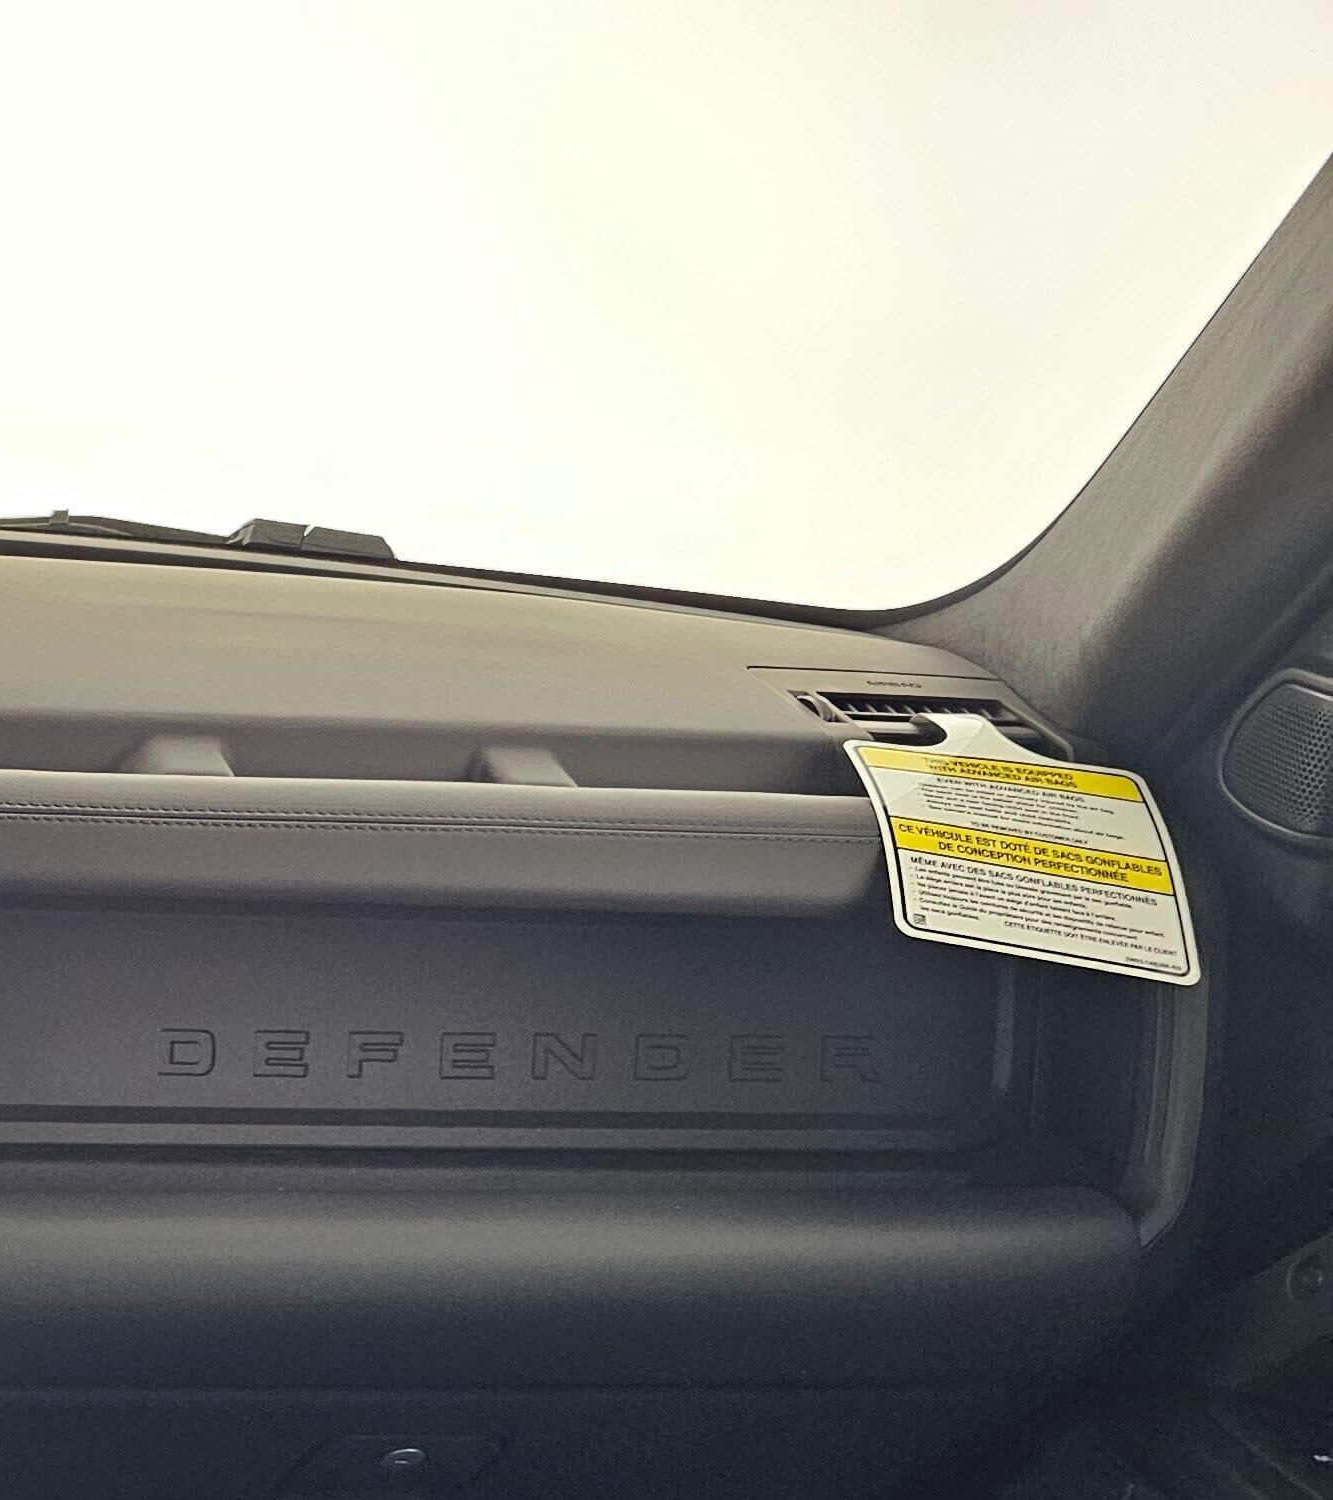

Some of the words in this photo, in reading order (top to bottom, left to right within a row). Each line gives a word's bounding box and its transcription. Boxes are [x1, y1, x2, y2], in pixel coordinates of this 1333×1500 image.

[899, 824, 914, 833] CE
[916, 826, 973, 844] VÉHICULE
[976, 836, 996, 848] EST
[1000, 840, 1031, 854] DOTÉ
[1034, 847, 1049, 857] DE
[1052, 849, 1082, 862] SACS
[1086, 855, 1162, 876] GONFLABLES
[938, 841, 954, 852] DE
[957, 845, 1031, 865] CONCEPTION
[1034, 858, 1129, 882] PERFECTIONNÉE
[941, 862, 965, 872] AVEC
[968, 866, 986, 876] DES
[988, 870, 1013, 880] SACS
[1016, 874, 1078, 892] GONFLABLES
[1081, 886, 1158, 906] PERFECTIONNÉS
[158, 1029, 880, 1083] DEFENDER
